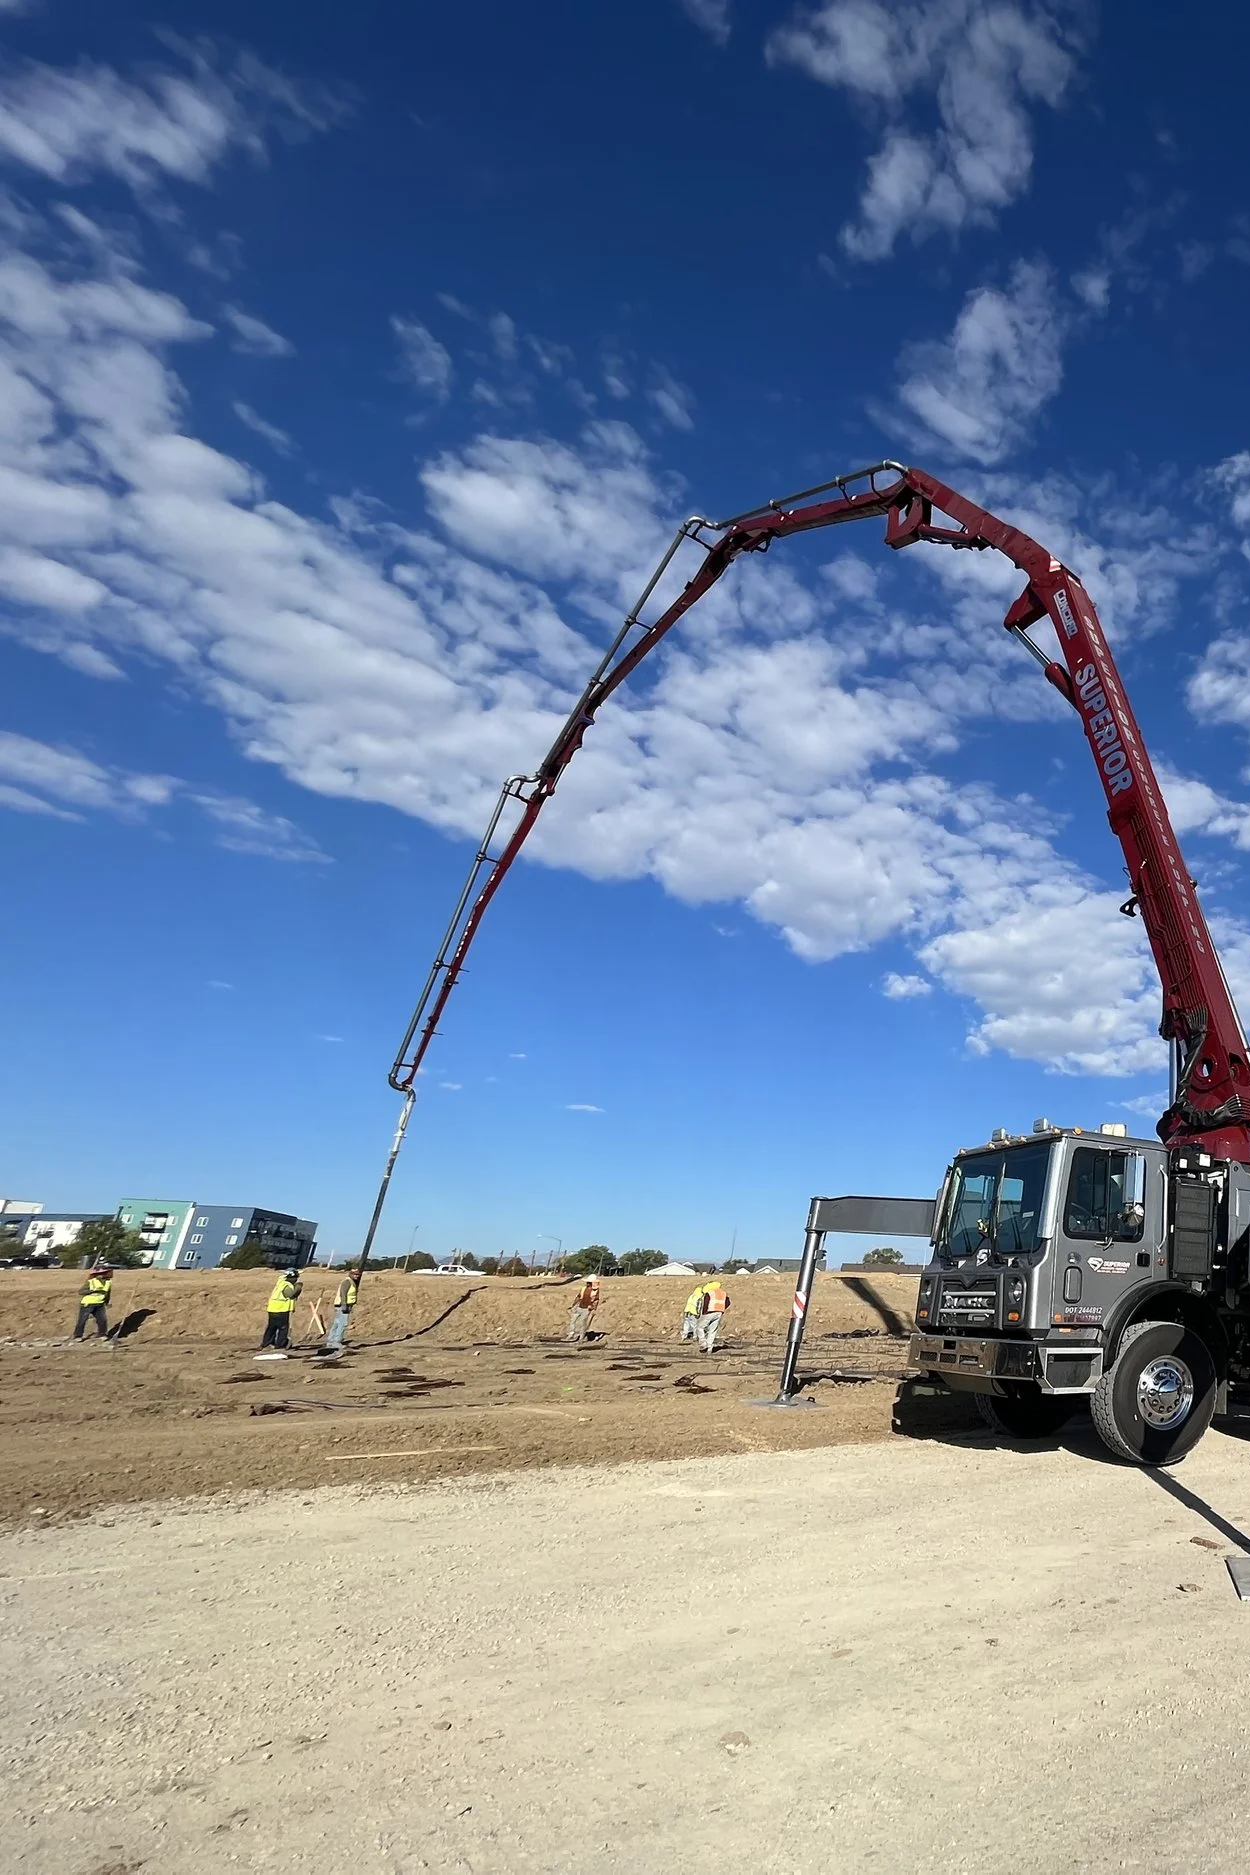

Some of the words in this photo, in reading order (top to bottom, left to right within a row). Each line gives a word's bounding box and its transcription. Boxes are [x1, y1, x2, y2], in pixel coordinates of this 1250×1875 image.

[1053, 588, 1078, 637] CONCORD
[1075, 663, 1133, 797] SUPERIOR
[1083, 615, 1136, 745] SUPERIOR
[1132, 749, 1170, 847] CONCRETE
[1167, 854, 1205, 954] PUMPING
[1064, 1306, 1077, 1314] DOT
